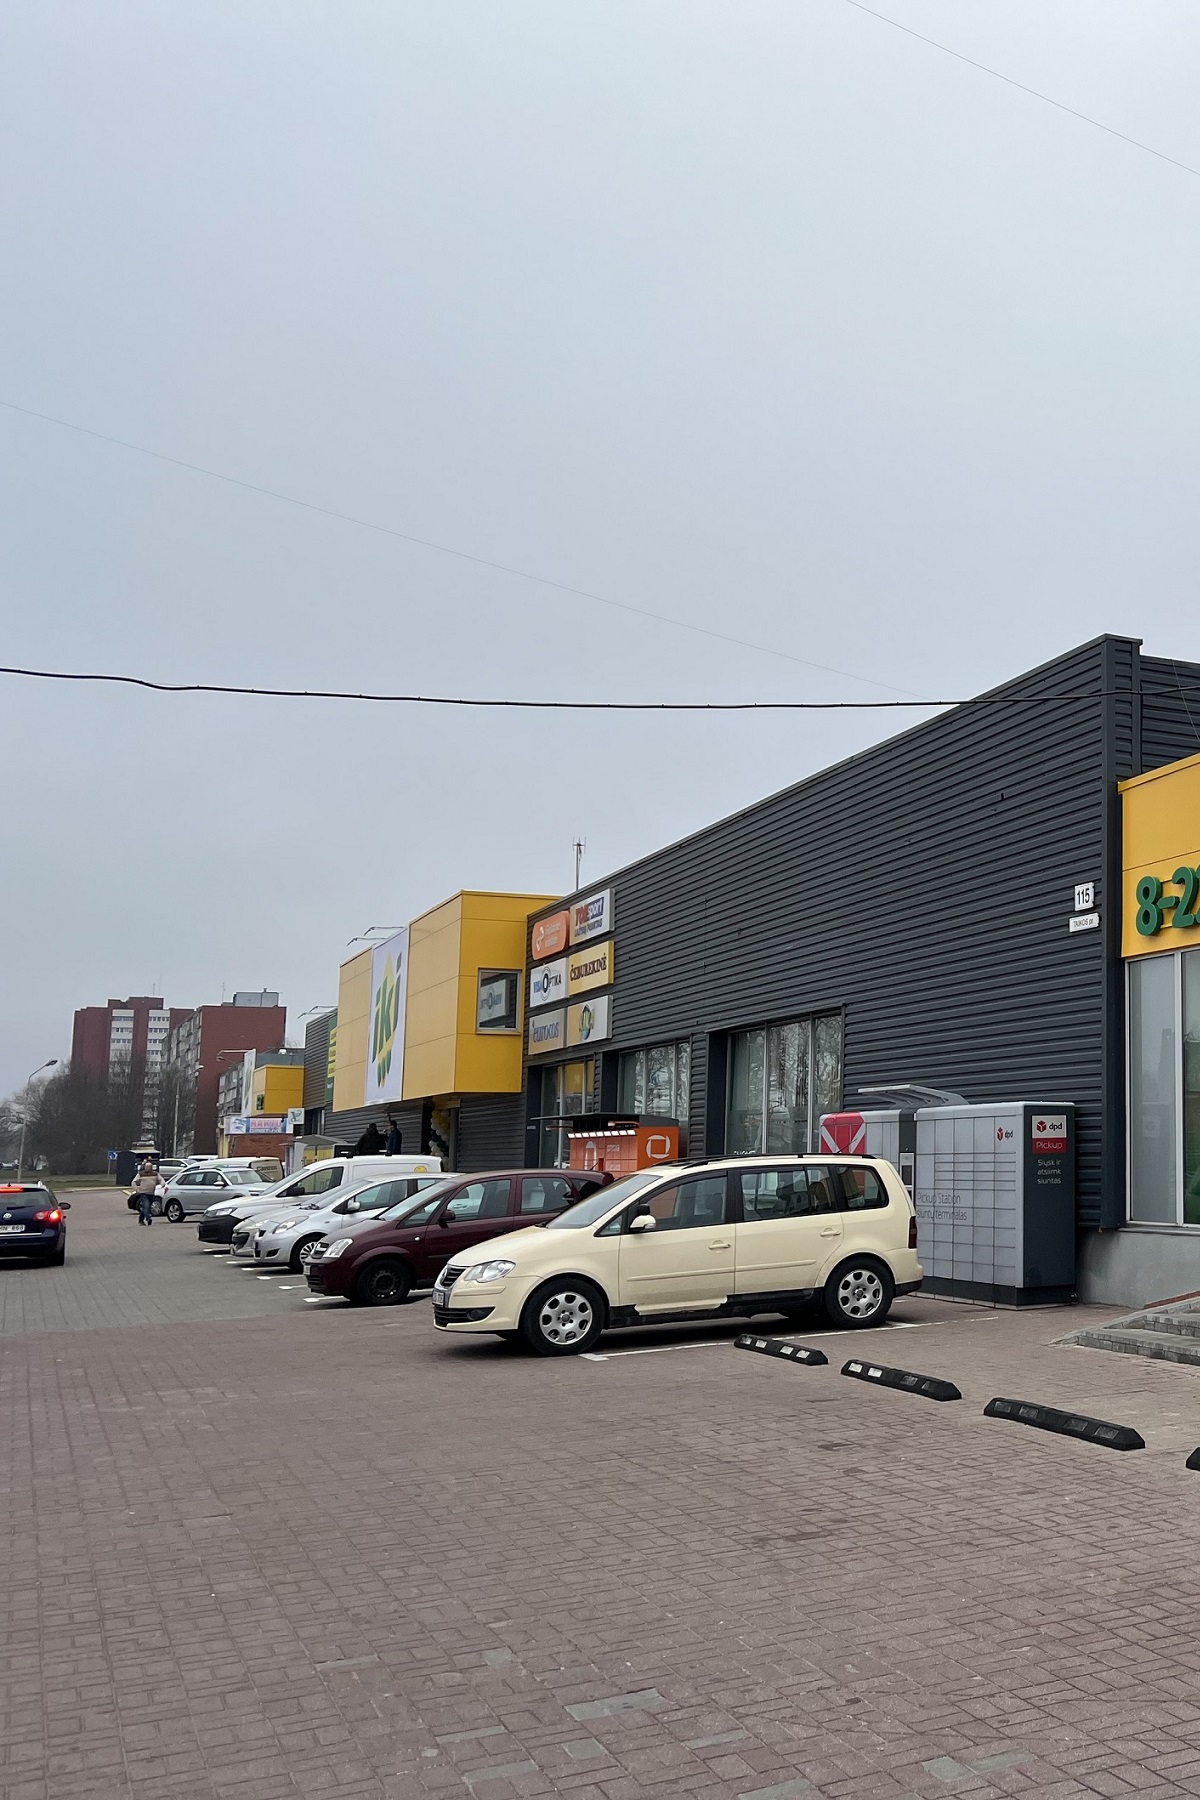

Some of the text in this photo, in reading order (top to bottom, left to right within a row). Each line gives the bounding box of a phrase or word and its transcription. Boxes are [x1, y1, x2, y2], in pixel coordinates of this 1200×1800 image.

[1076, 887, 1091, 905] 115
[372, 951, 402, 1063] iki
[1048, 1122, 1063, 1131] dpd
[1004, 1129, 1014, 1140] dpd
[1035, 1141, 1063, 1149] Pickup
